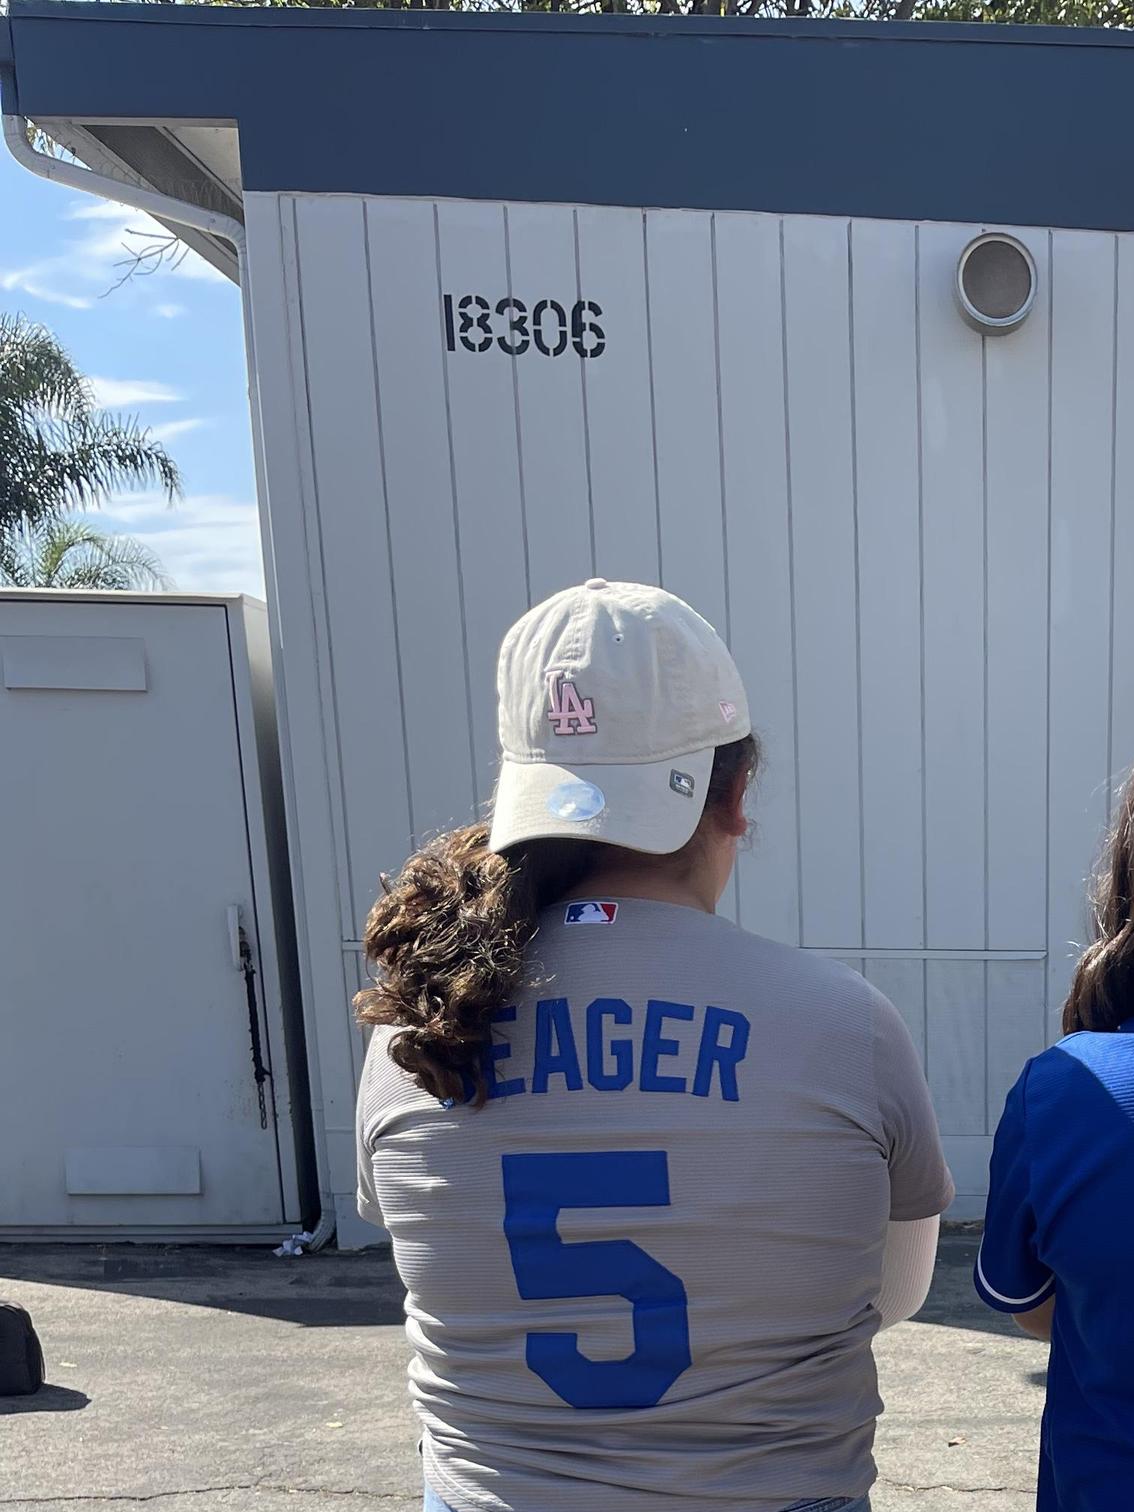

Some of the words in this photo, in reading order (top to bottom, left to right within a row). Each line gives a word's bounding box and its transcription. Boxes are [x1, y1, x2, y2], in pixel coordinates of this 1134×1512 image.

[443, 294, 606, 358] 18306
[546, 669, 597, 735] LA
[441, 997, 751, 1109] EAGER
[501, 1150, 692, 1409] 5
